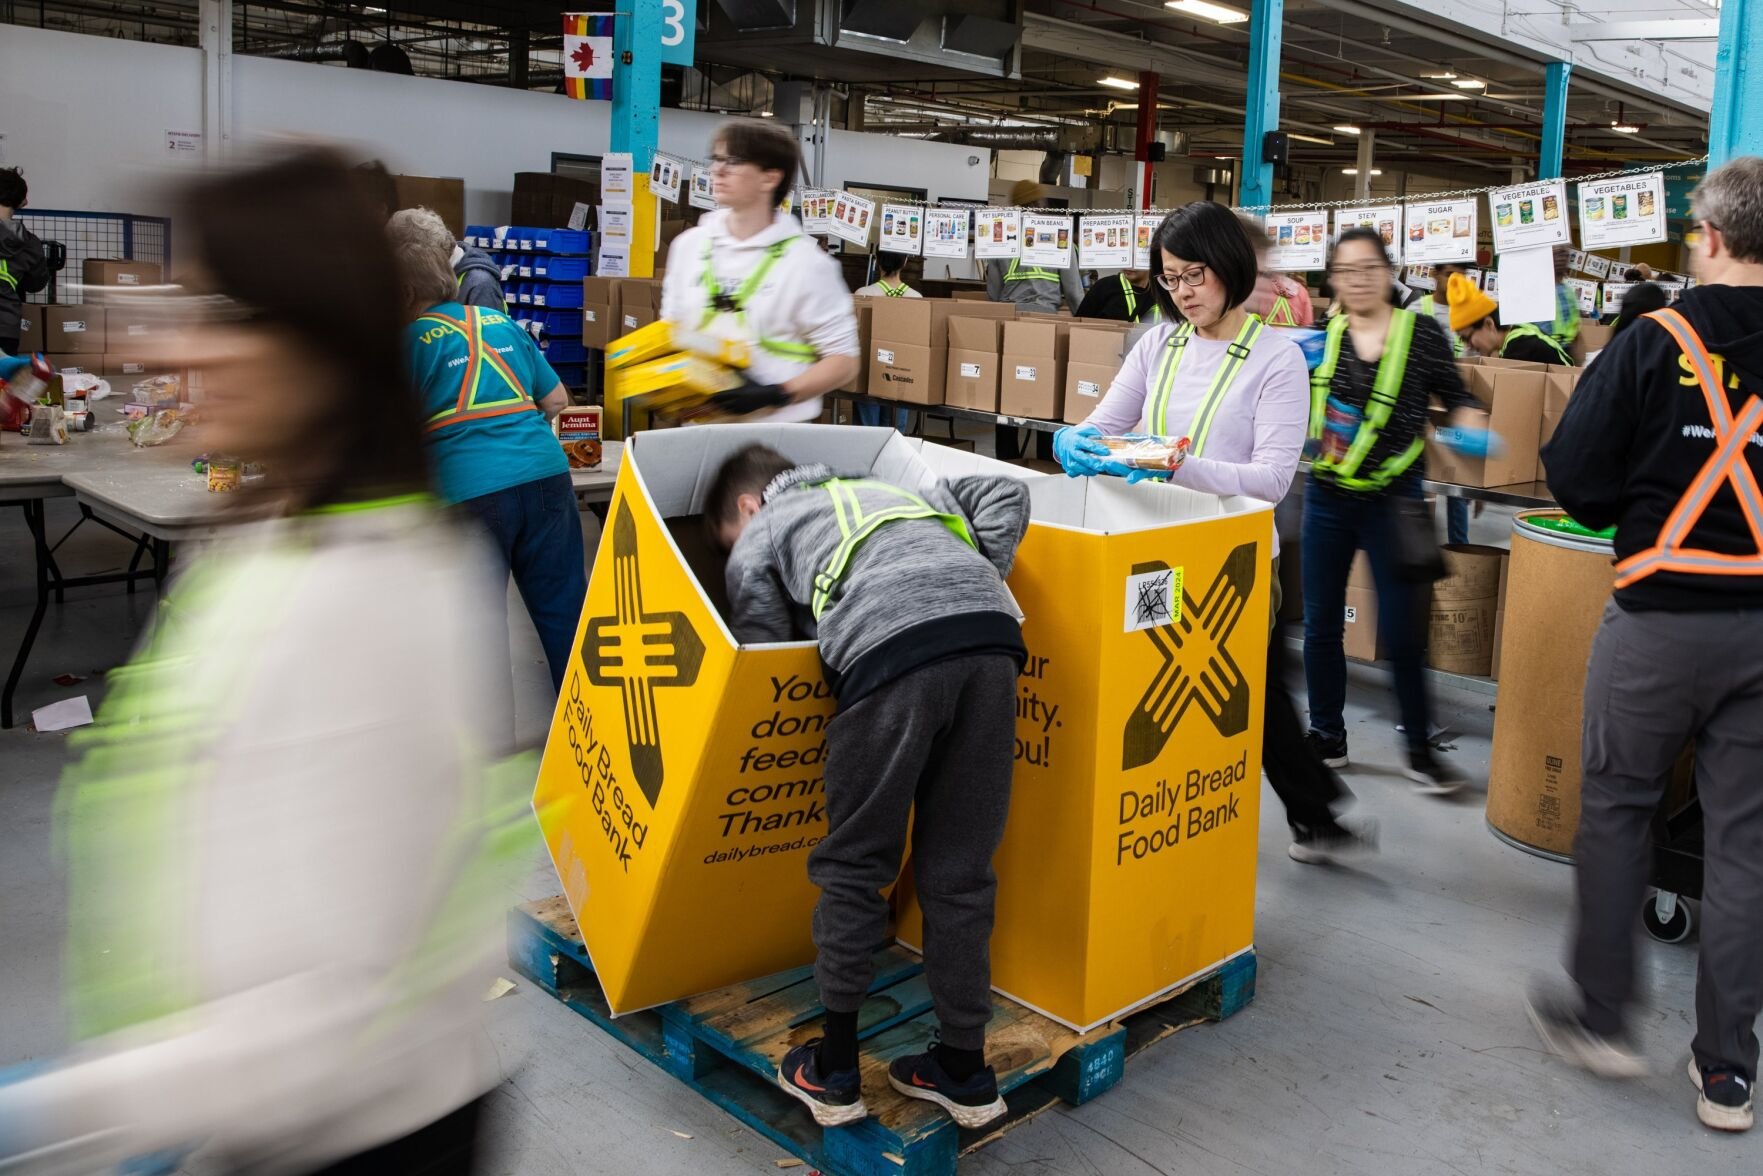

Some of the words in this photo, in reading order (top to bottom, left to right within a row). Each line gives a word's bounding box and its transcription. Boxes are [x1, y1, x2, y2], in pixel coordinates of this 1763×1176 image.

[660, 0, 685, 46] 3
[1502, 187, 1550, 201] VEGETABLES
[1594, 182, 1647, 195] VEGETABLES
[902, 208, 919, 216] BUTTER
[1428, 206, 1453, 214] SUGAR
[974, 366, 980, 374] 7
[567, 416, 591, 424] Aunt
[1347, 608, 1354, 618] 5
[1022, 655, 1050, 679] ur
[770, 675, 834, 703] You
[570, 669, 598, 755] Daily
[596, 744, 648, 850] Bread
[1014, 735, 1050, 768] ou!
[563, 699, 593, 789] Food
[592, 779, 632, 873] Bank
[1119, 779, 1182, 825] Daily
[1185, 749, 1248, 802] Bread
[718, 801, 824, 837] Thank
[1117, 813, 1181, 866] Food
[1186, 792, 1240, 839] Bank
